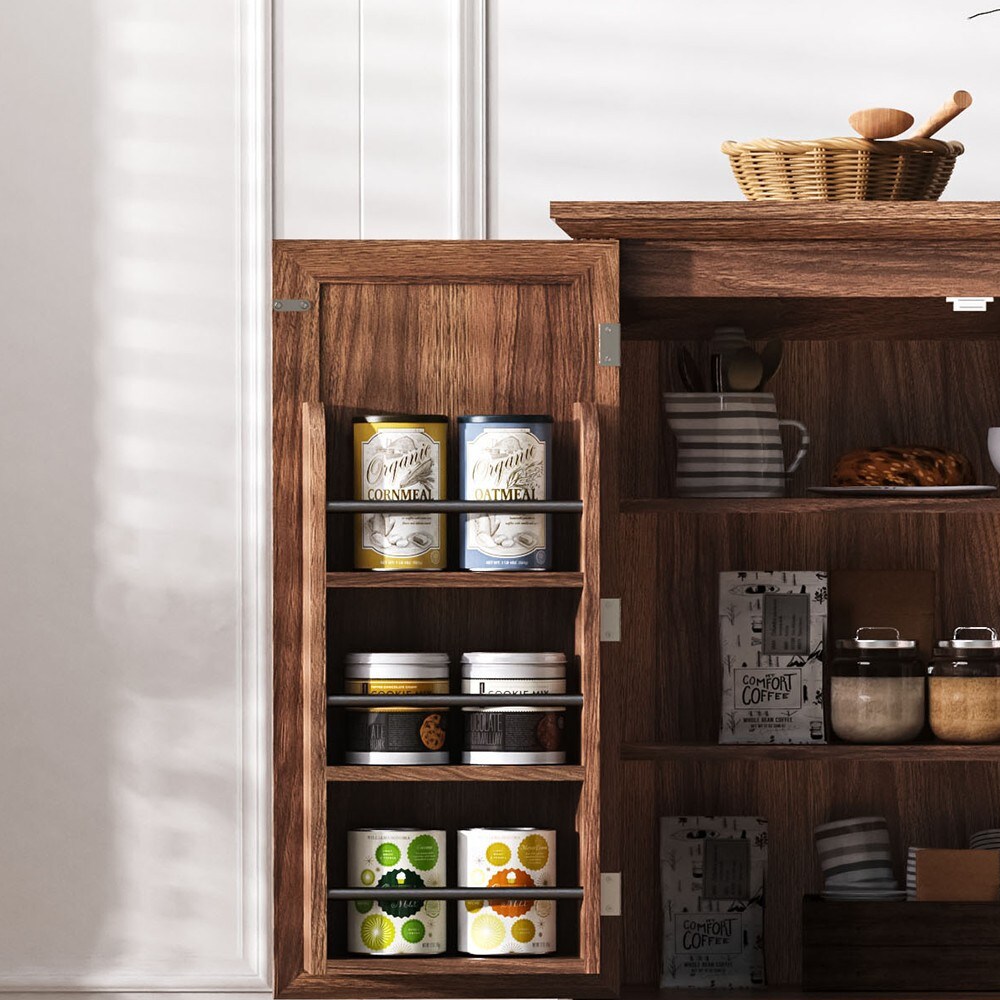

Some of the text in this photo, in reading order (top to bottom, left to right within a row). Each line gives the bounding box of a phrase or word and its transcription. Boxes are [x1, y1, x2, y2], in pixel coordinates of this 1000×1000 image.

[366, 442, 431, 485] Organic
[472, 445, 537, 484] Organic
[367, 488, 435, 501] CORNMEAL
[474, 488, 539, 501] OATMEAL
[742, 673, 798, 692] COMFORT
[741, 685, 790, 706] COFFEE
[683, 918, 739, 937] COMFORT
[682, 930, 731, 950] COFFEE
